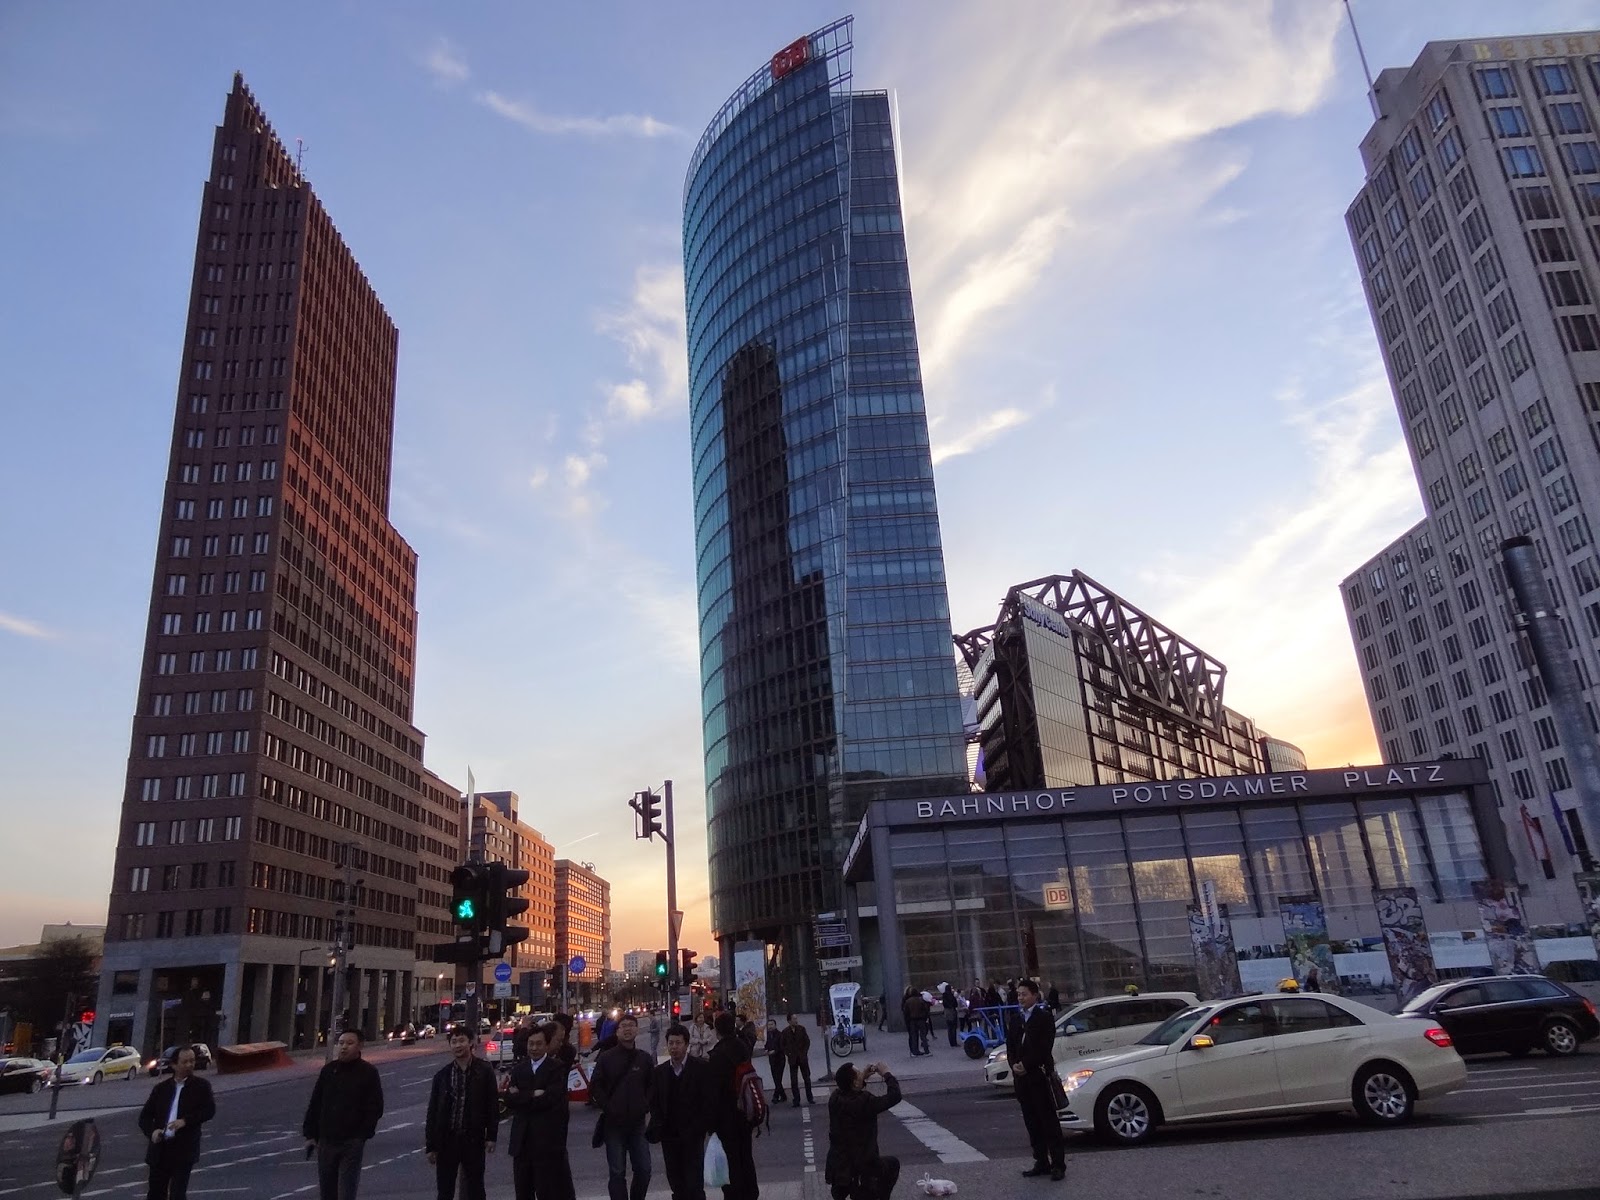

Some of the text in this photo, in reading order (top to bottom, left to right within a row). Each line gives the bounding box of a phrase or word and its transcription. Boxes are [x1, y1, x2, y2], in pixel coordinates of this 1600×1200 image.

[1024, 602, 1045, 628] Sony
[917, 765, 1444, 818] BAHNHOF POTSDAMER PLATZ
[1049, 889, 1068, 902] DB
